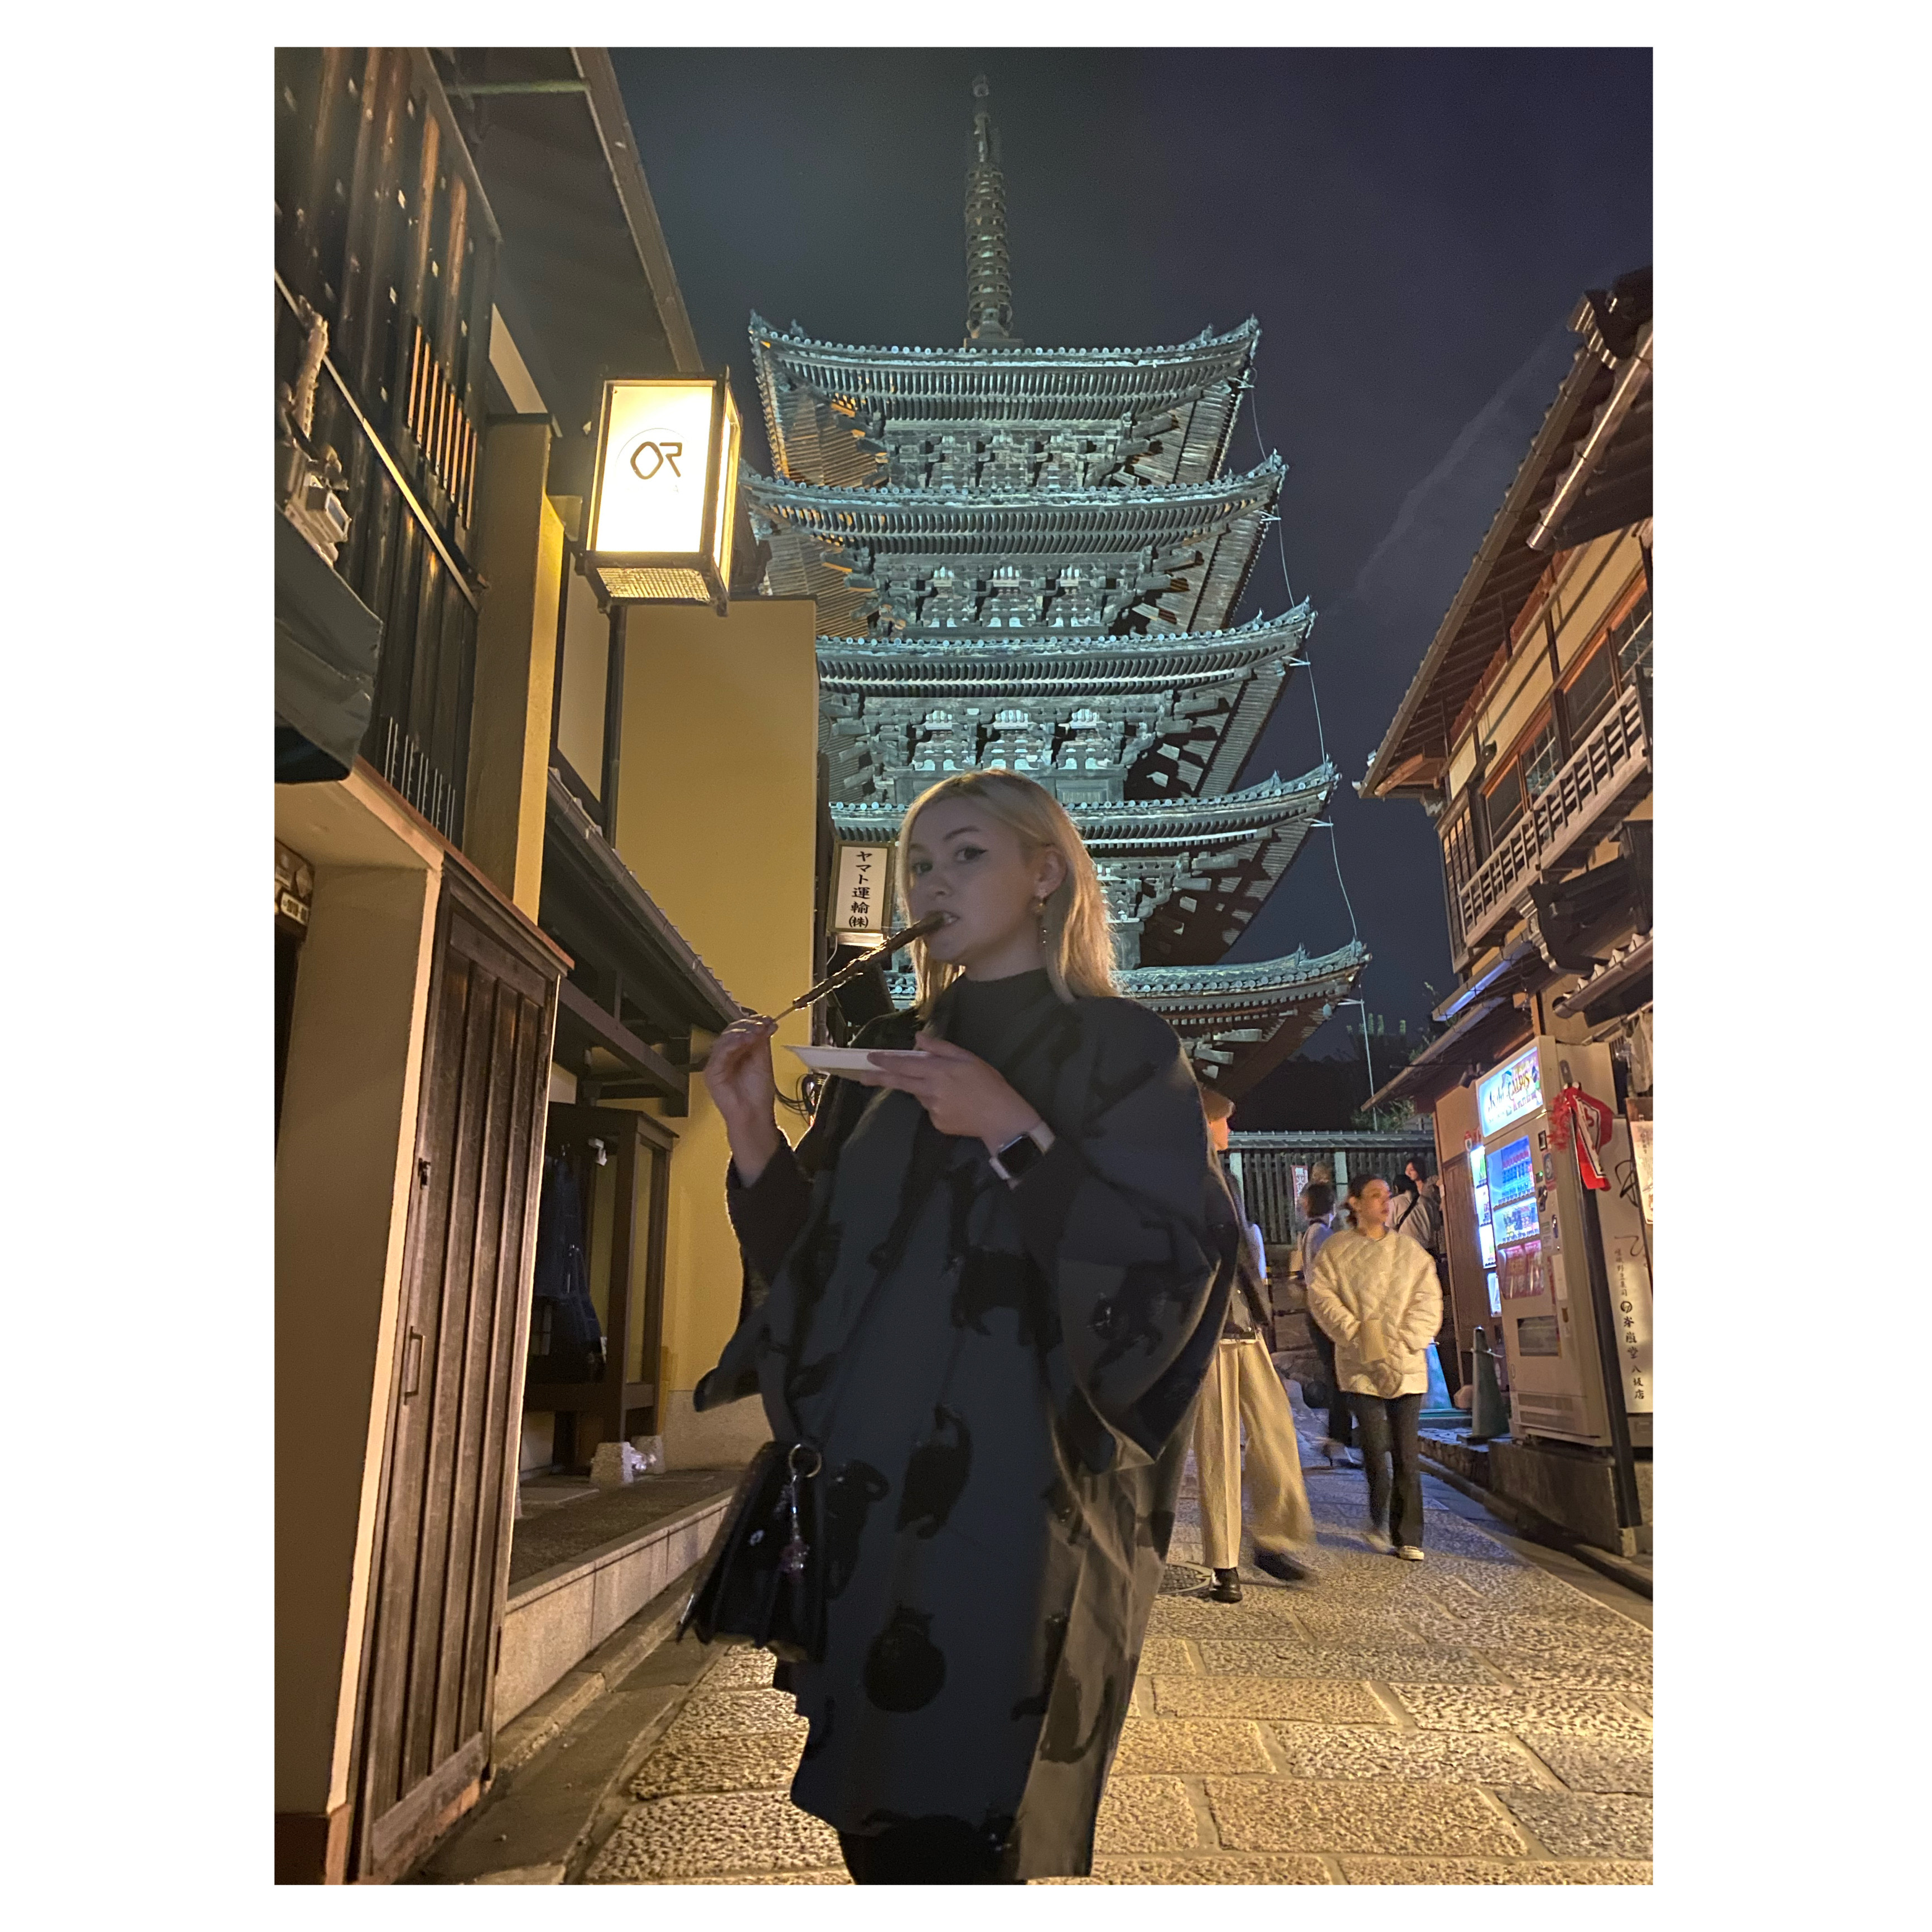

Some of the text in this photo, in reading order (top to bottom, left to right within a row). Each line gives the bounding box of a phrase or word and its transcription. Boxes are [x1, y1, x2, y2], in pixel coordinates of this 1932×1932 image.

[630, 441, 683, 480] OR
[848, 851, 873, 928] ヤマト運輸(株)
